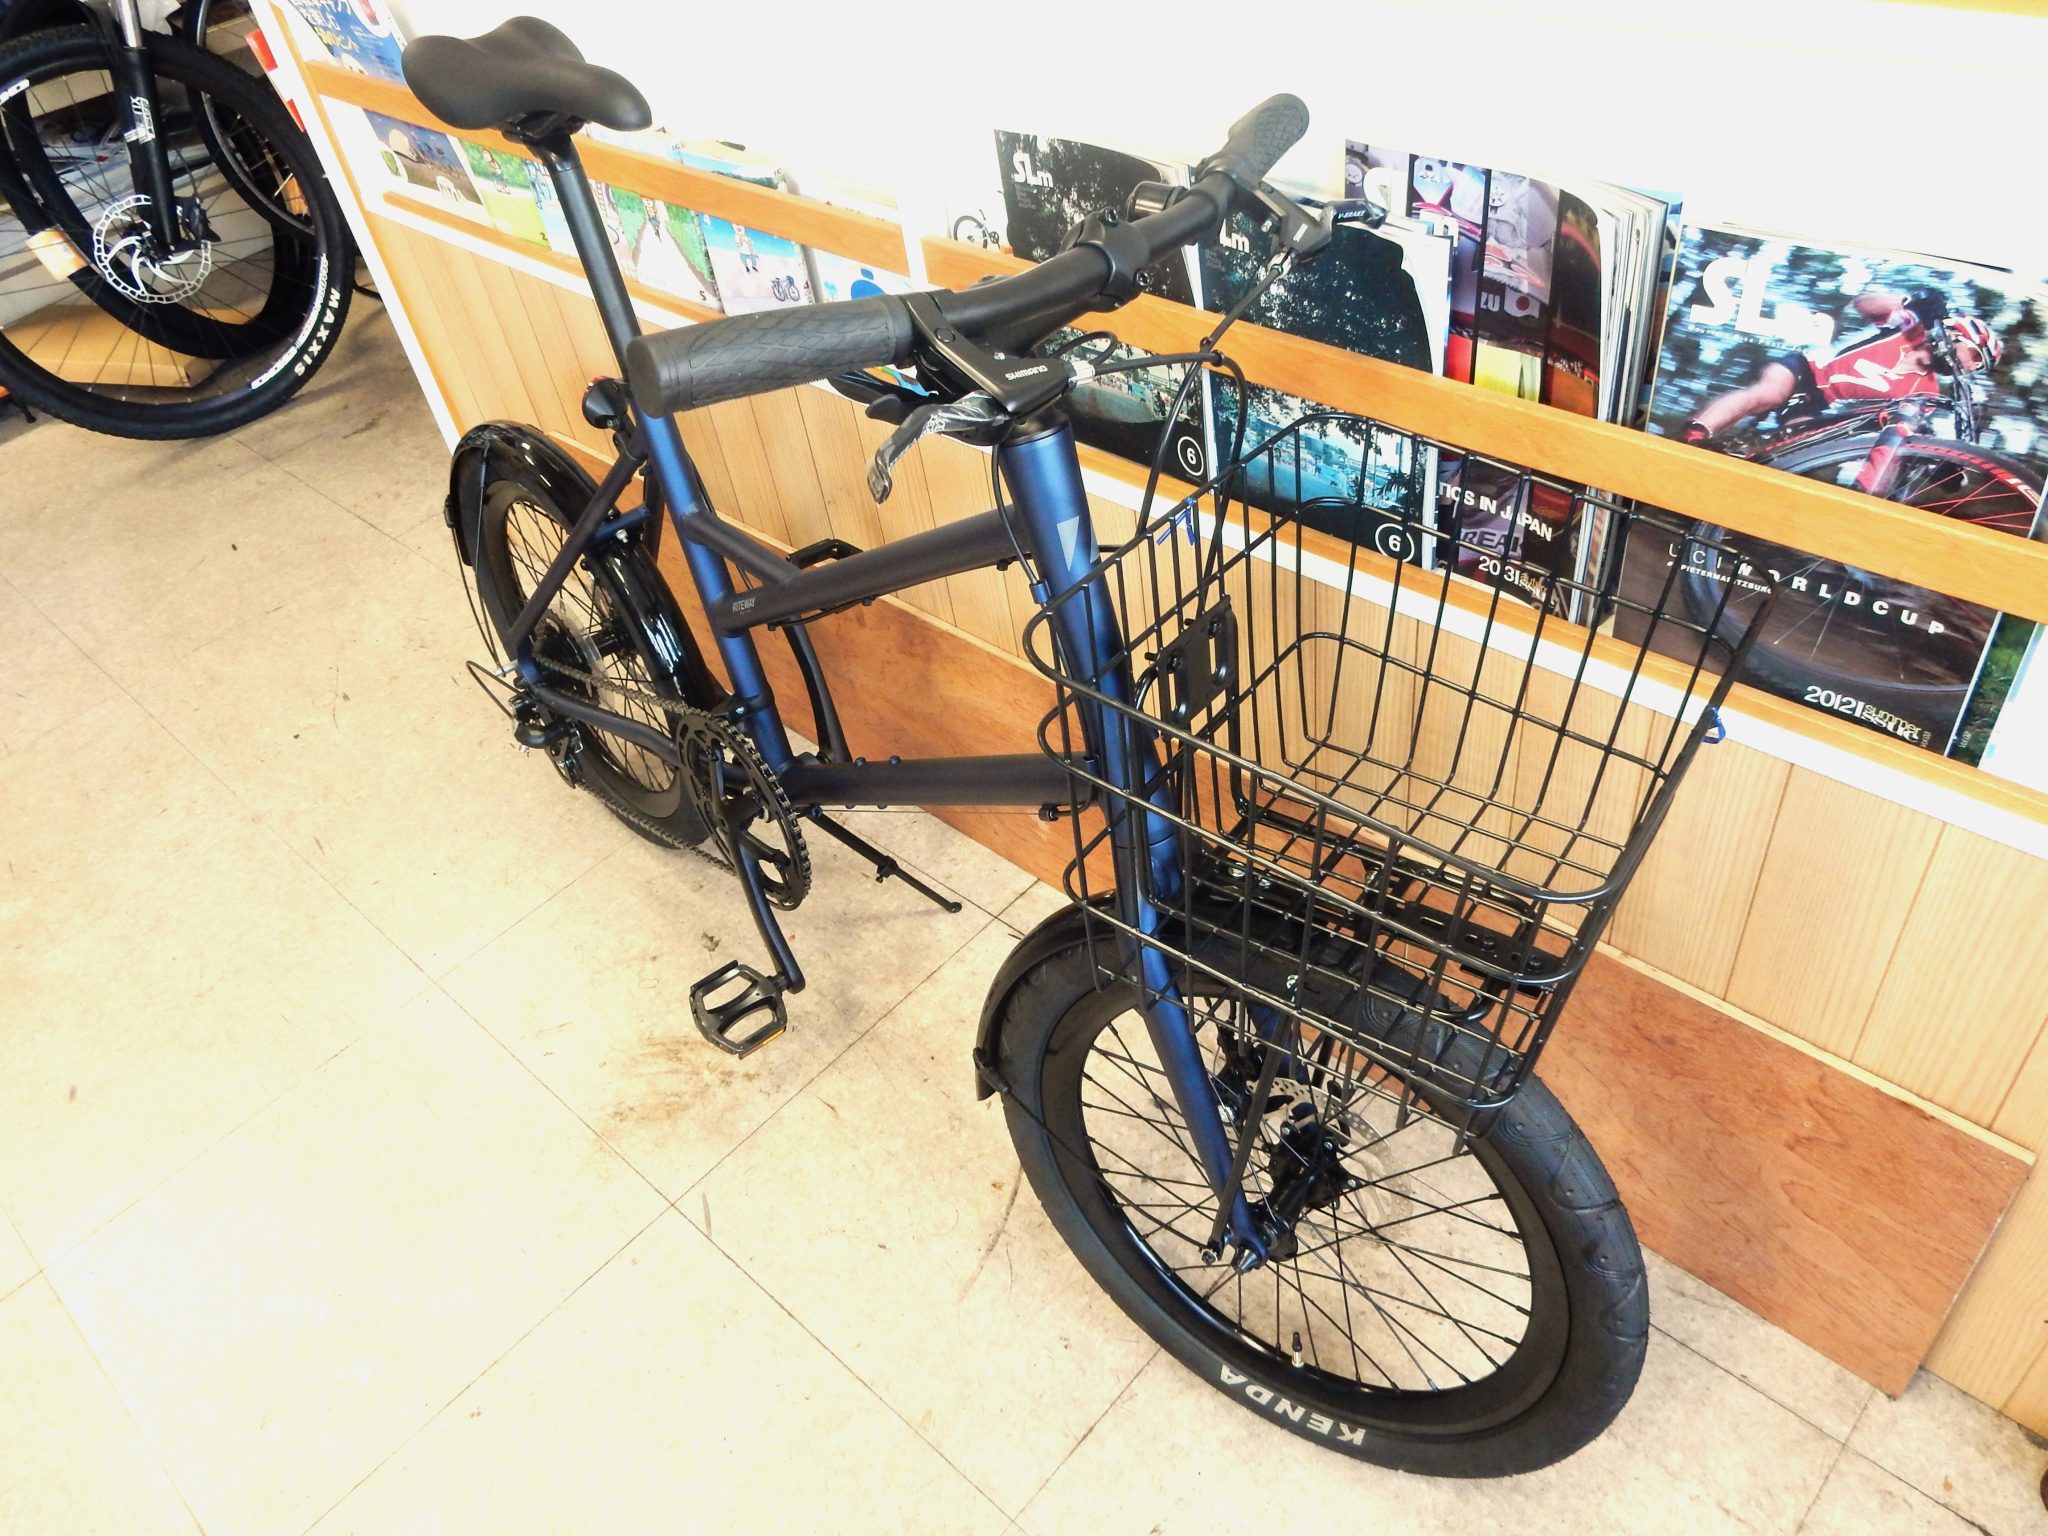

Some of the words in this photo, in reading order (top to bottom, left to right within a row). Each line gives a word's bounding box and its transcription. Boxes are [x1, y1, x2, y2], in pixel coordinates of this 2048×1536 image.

[1011, 152, 1054, 188] SLm
[1219, 218, 1250, 253] Lm
[1690, 256, 1836, 346] SLm
[294, 287, 341, 376] MAXXIS
[1004, 364, 1048, 381] SHIMANO
[1186, 447, 1197, 465] 6
[1479, 495, 1497, 515] IN
[1388, 534, 1402, 553] 6
[1478, 555, 1515, 583] 203
[1680, 563, 1773, 595] PIETERMATZBUR
[1219, 1363, 1366, 1446] KENDA
